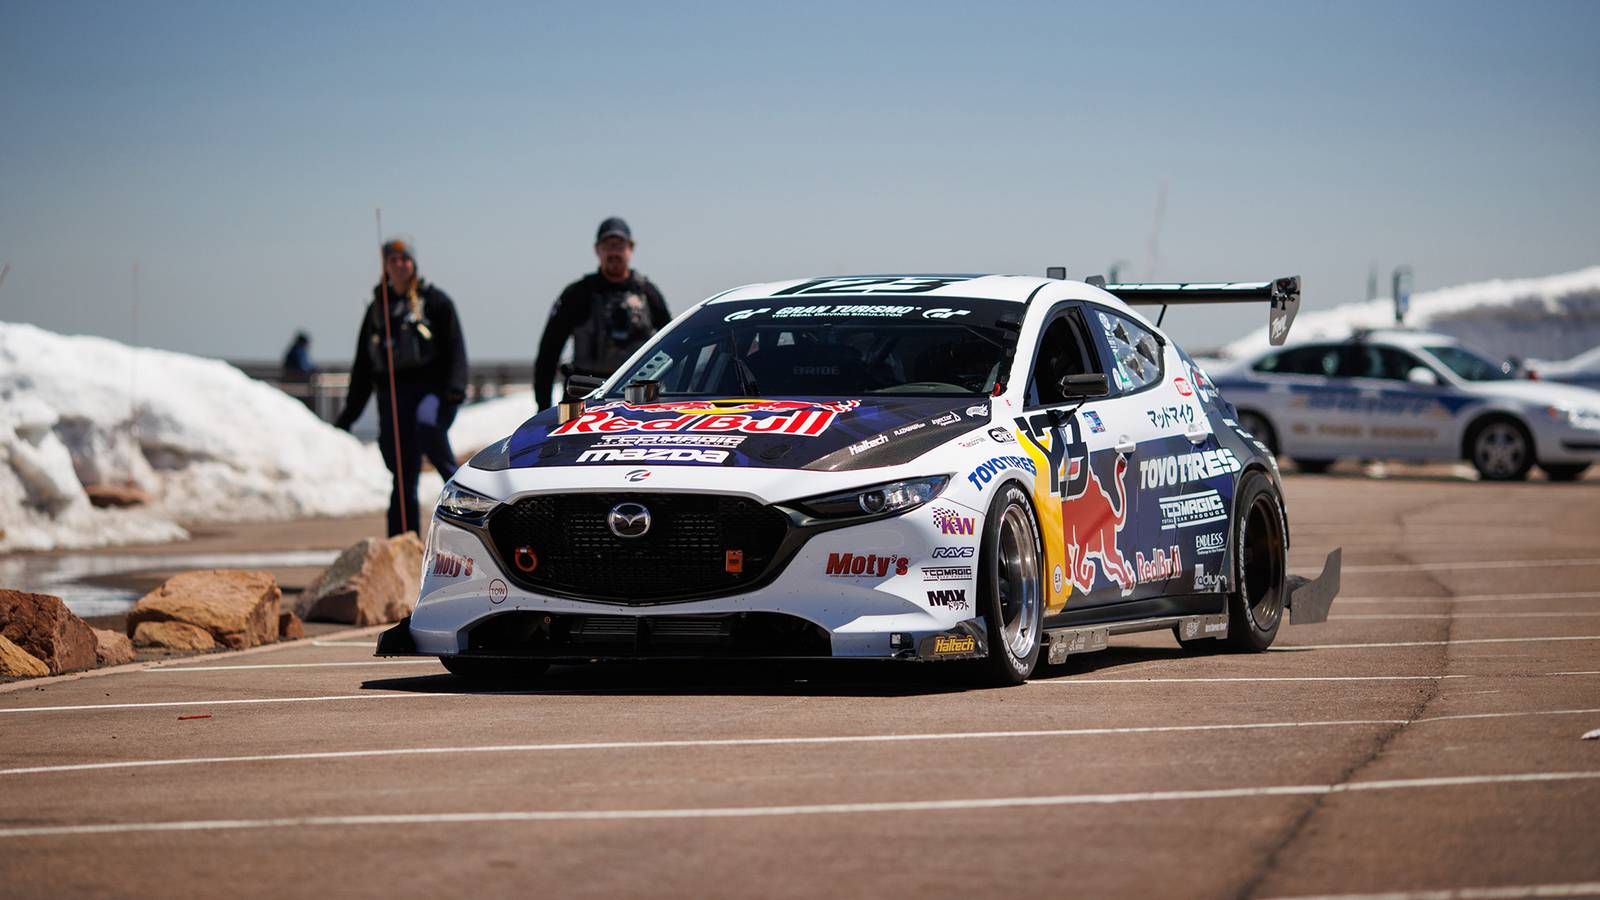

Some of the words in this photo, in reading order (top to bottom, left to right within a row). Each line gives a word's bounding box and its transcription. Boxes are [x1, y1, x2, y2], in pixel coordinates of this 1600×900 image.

[776, 305, 831, 315] GRAN
[832, 305, 915, 314] TURISMO
[792, 365, 840, 376] BRIDE
[547, 411, 697, 437] Red
[693, 411, 838, 437] Bull
[1147, 404, 1194, 429] マッドマイク
[849, 433, 889, 456] Haltech
[575, 448, 730, 463] mazda
[968, 457, 1006, 492] TOYO
[1003, 455, 1037, 477] TIRES
[1139, 456, 1178, 489] TOYO
[1177, 448, 1241, 483] TIRES
[1006, 488, 1026, 504] TOYO
[941, 516, 976, 536] KW
[1195, 532, 1224, 548] ENDLESS
[932, 547, 974, 558] RAYS
[825, 552, 910, 578] Moty's
[1136, 548, 1159, 585] Red
[491, 587, 506, 596] TOW
[927, 590, 966, 607] MAX
[935, 635, 975, 655] Haltech
